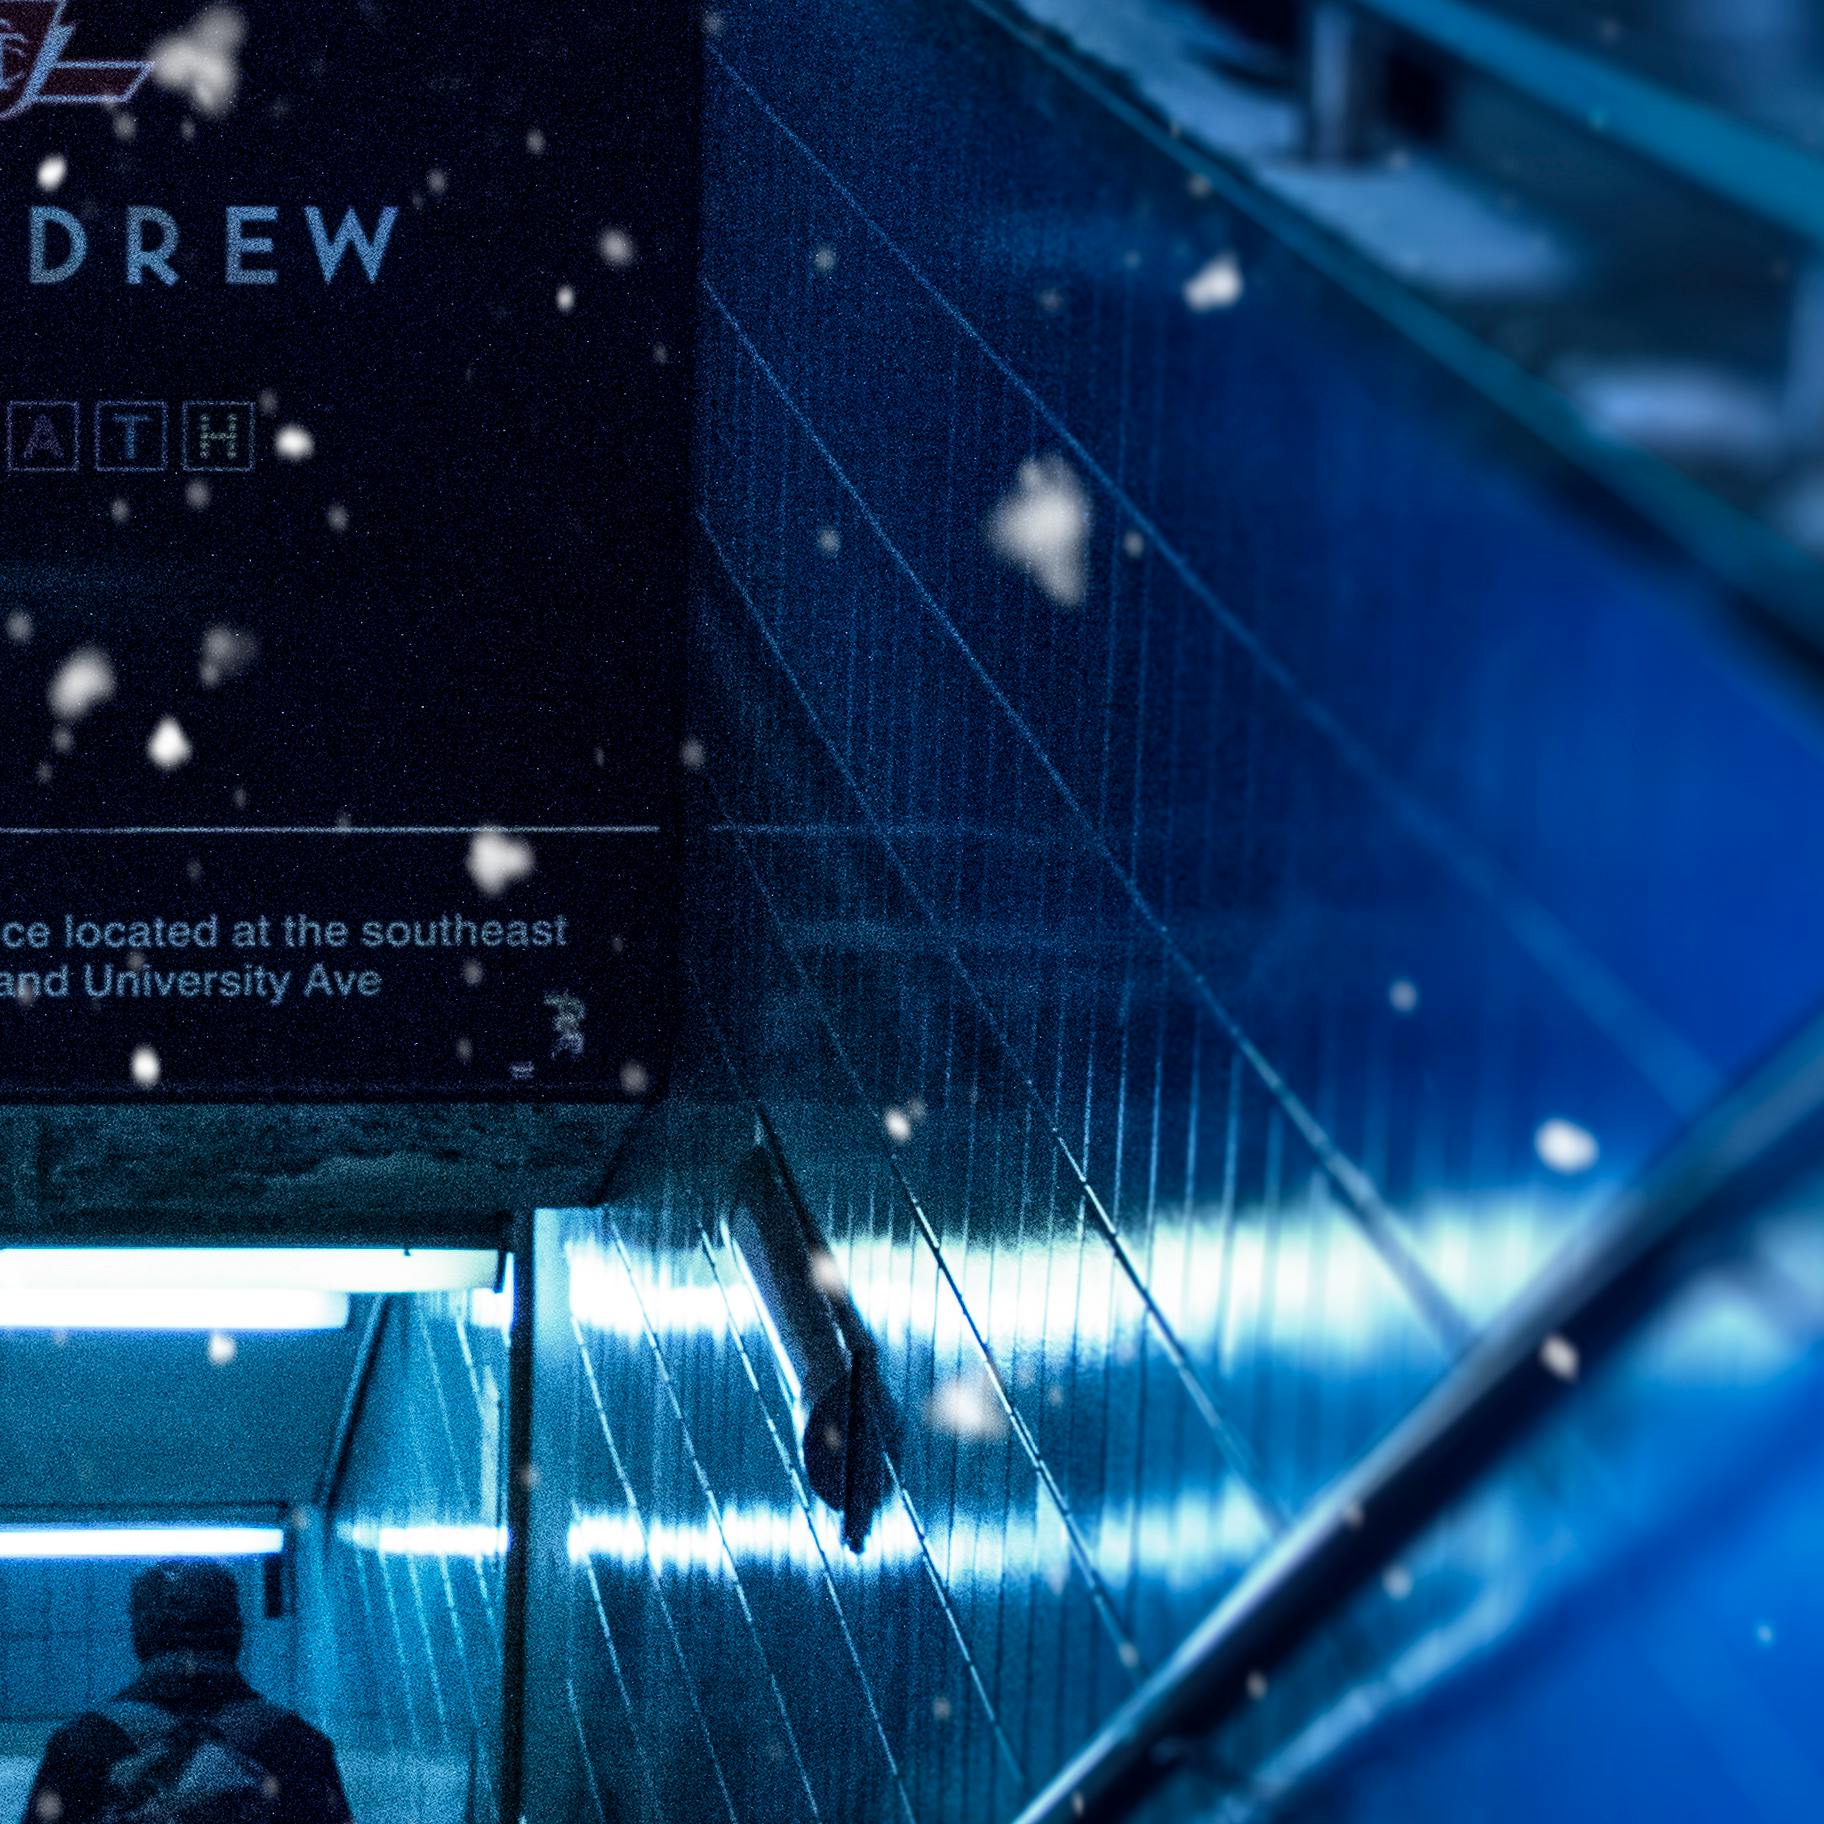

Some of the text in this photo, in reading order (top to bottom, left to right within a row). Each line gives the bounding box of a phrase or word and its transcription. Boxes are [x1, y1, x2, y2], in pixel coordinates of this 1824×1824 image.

[65, 913, 219, 948] located
[232, 915, 272, 948] at
[283, 913, 349, 948] the
[360, 913, 569, 948] southeast
[84, 962, 290, 1006] University
[303, 962, 383, 998] Ave
